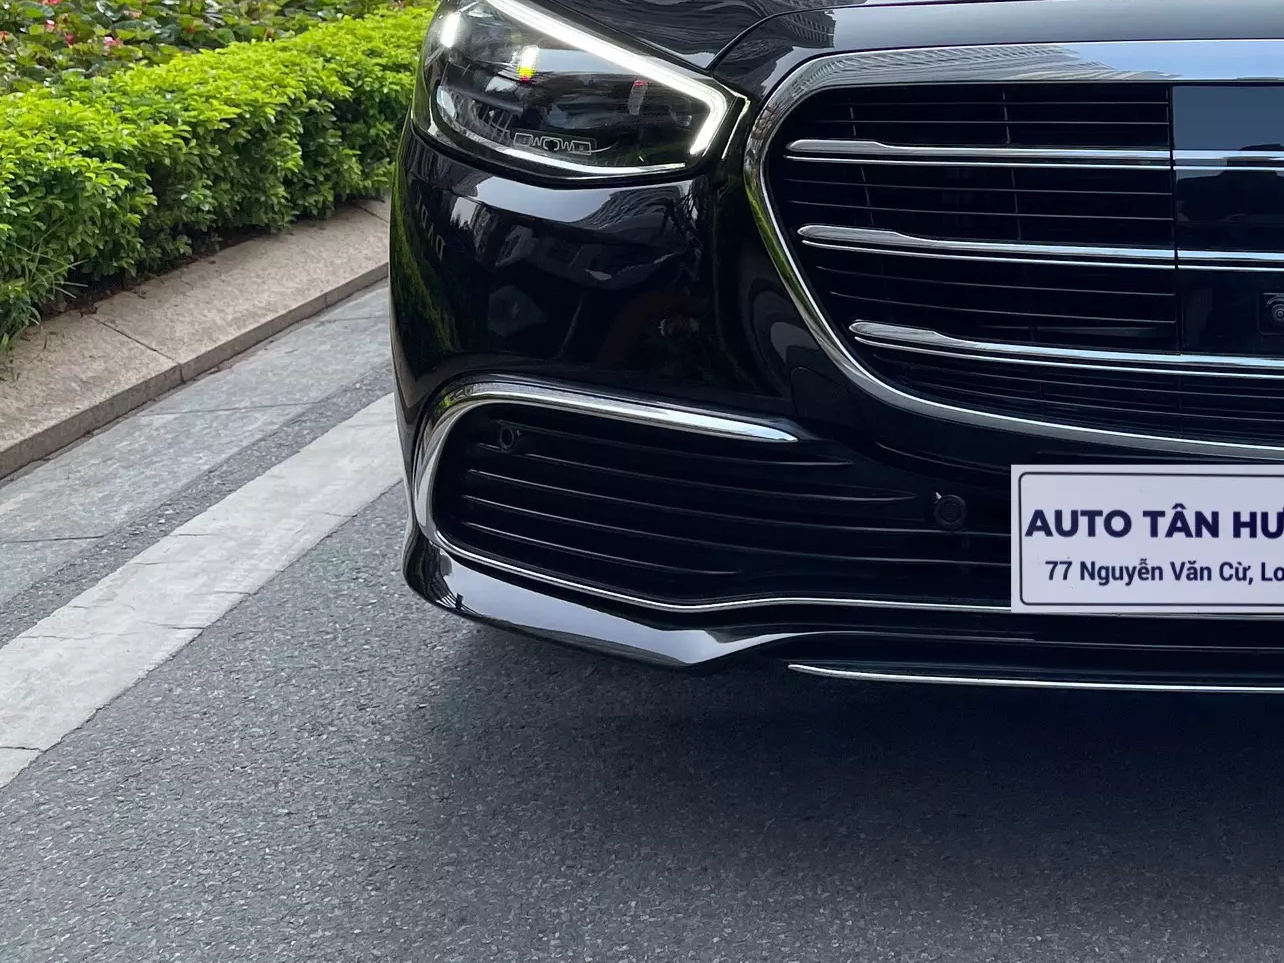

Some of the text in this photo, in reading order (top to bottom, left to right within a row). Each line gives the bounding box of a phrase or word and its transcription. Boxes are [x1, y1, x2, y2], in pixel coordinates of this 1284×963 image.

[1025, 510, 1132, 538] AUTO
[1143, 503, 1219, 538] TÂN
[1045, 561, 1072, 580] 77
[1080, 558, 1163, 586] Nguyễn
[1170, 561, 1212, 581] Văn
[1219, 562, 1254, 585] Cừ,
